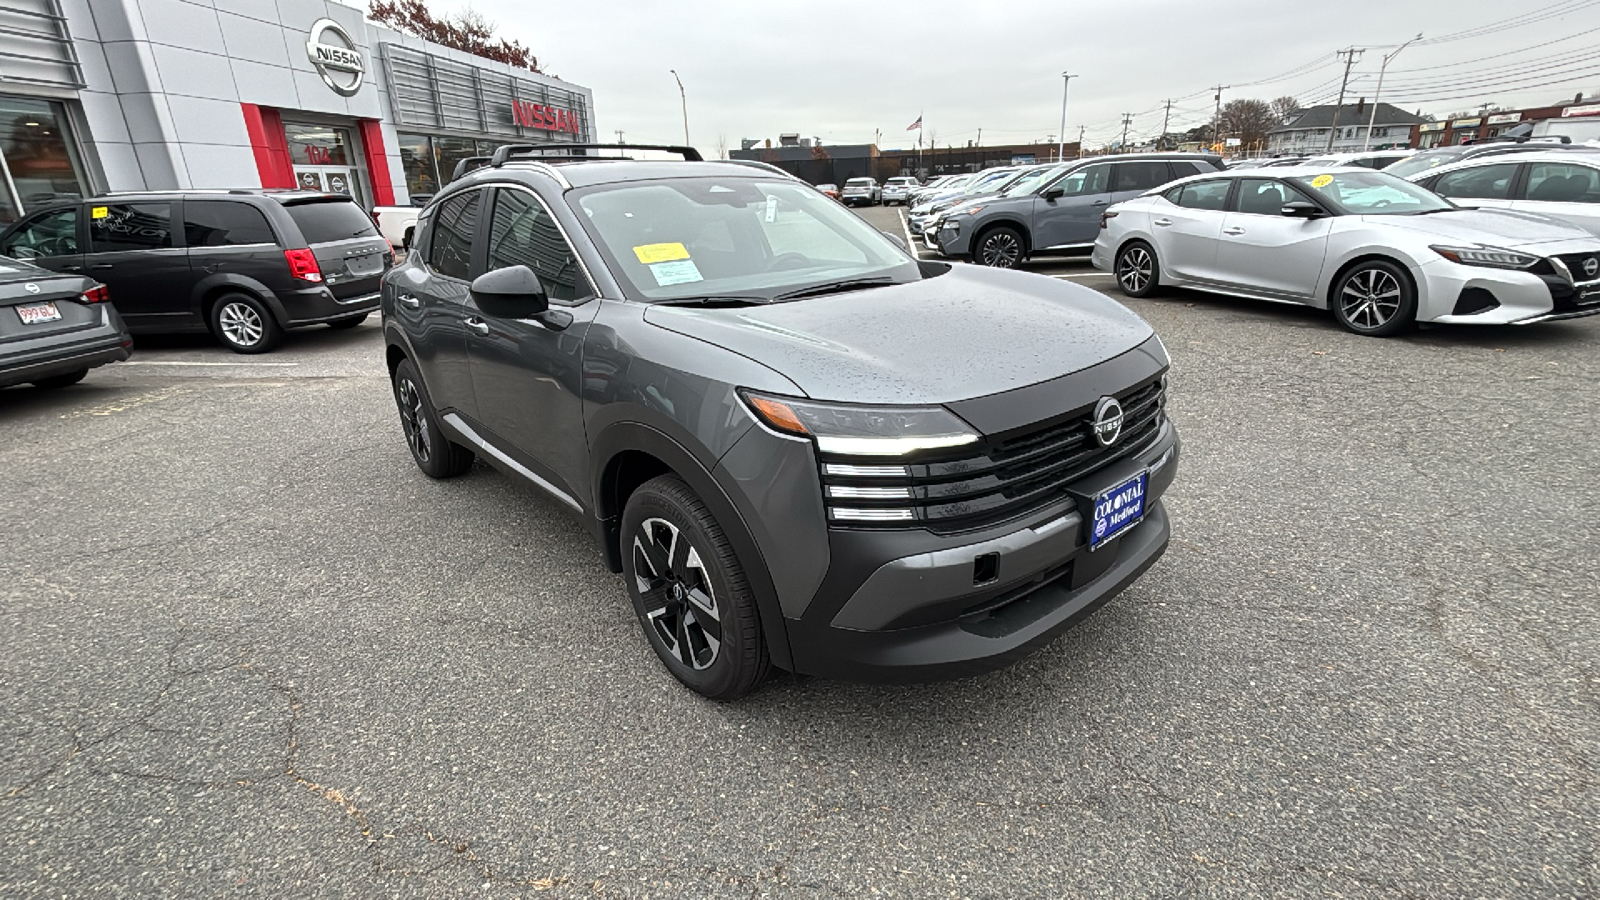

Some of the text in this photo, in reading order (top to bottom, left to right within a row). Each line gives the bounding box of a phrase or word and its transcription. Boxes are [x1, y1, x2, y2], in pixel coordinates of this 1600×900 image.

[316, 47, 363, 68] NISSAN
[512, 98, 578, 133] NISSAN
[303, 144, 331, 165] 104
[20, 307, 39, 320] 999
[1094, 482, 1144, 521] COLONIAL
[1110, 500, 1141, 527] Medford
